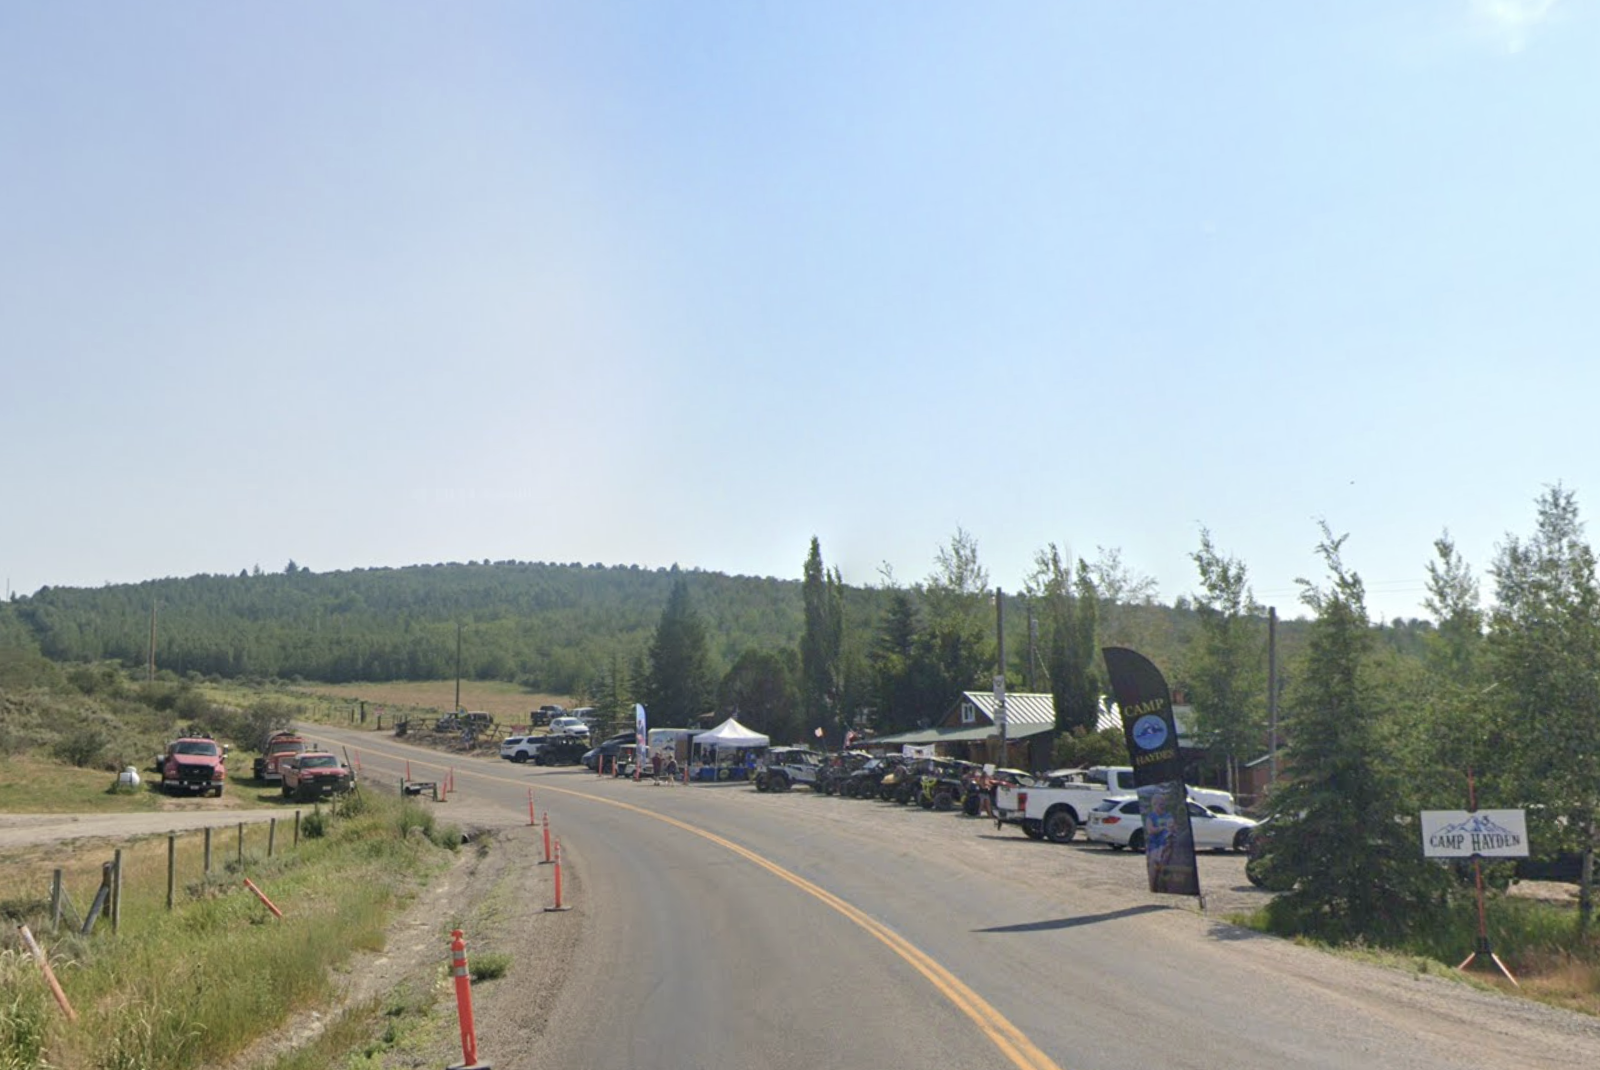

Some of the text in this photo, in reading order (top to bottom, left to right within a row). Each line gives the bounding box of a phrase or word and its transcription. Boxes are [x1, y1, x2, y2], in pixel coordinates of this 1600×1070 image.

[1124, 698, 1164, 717] CAMP
[1136, 749, 1174, 766] HAYDEN
[1430, 833, 1520, 851] CAMP HAYDEN
